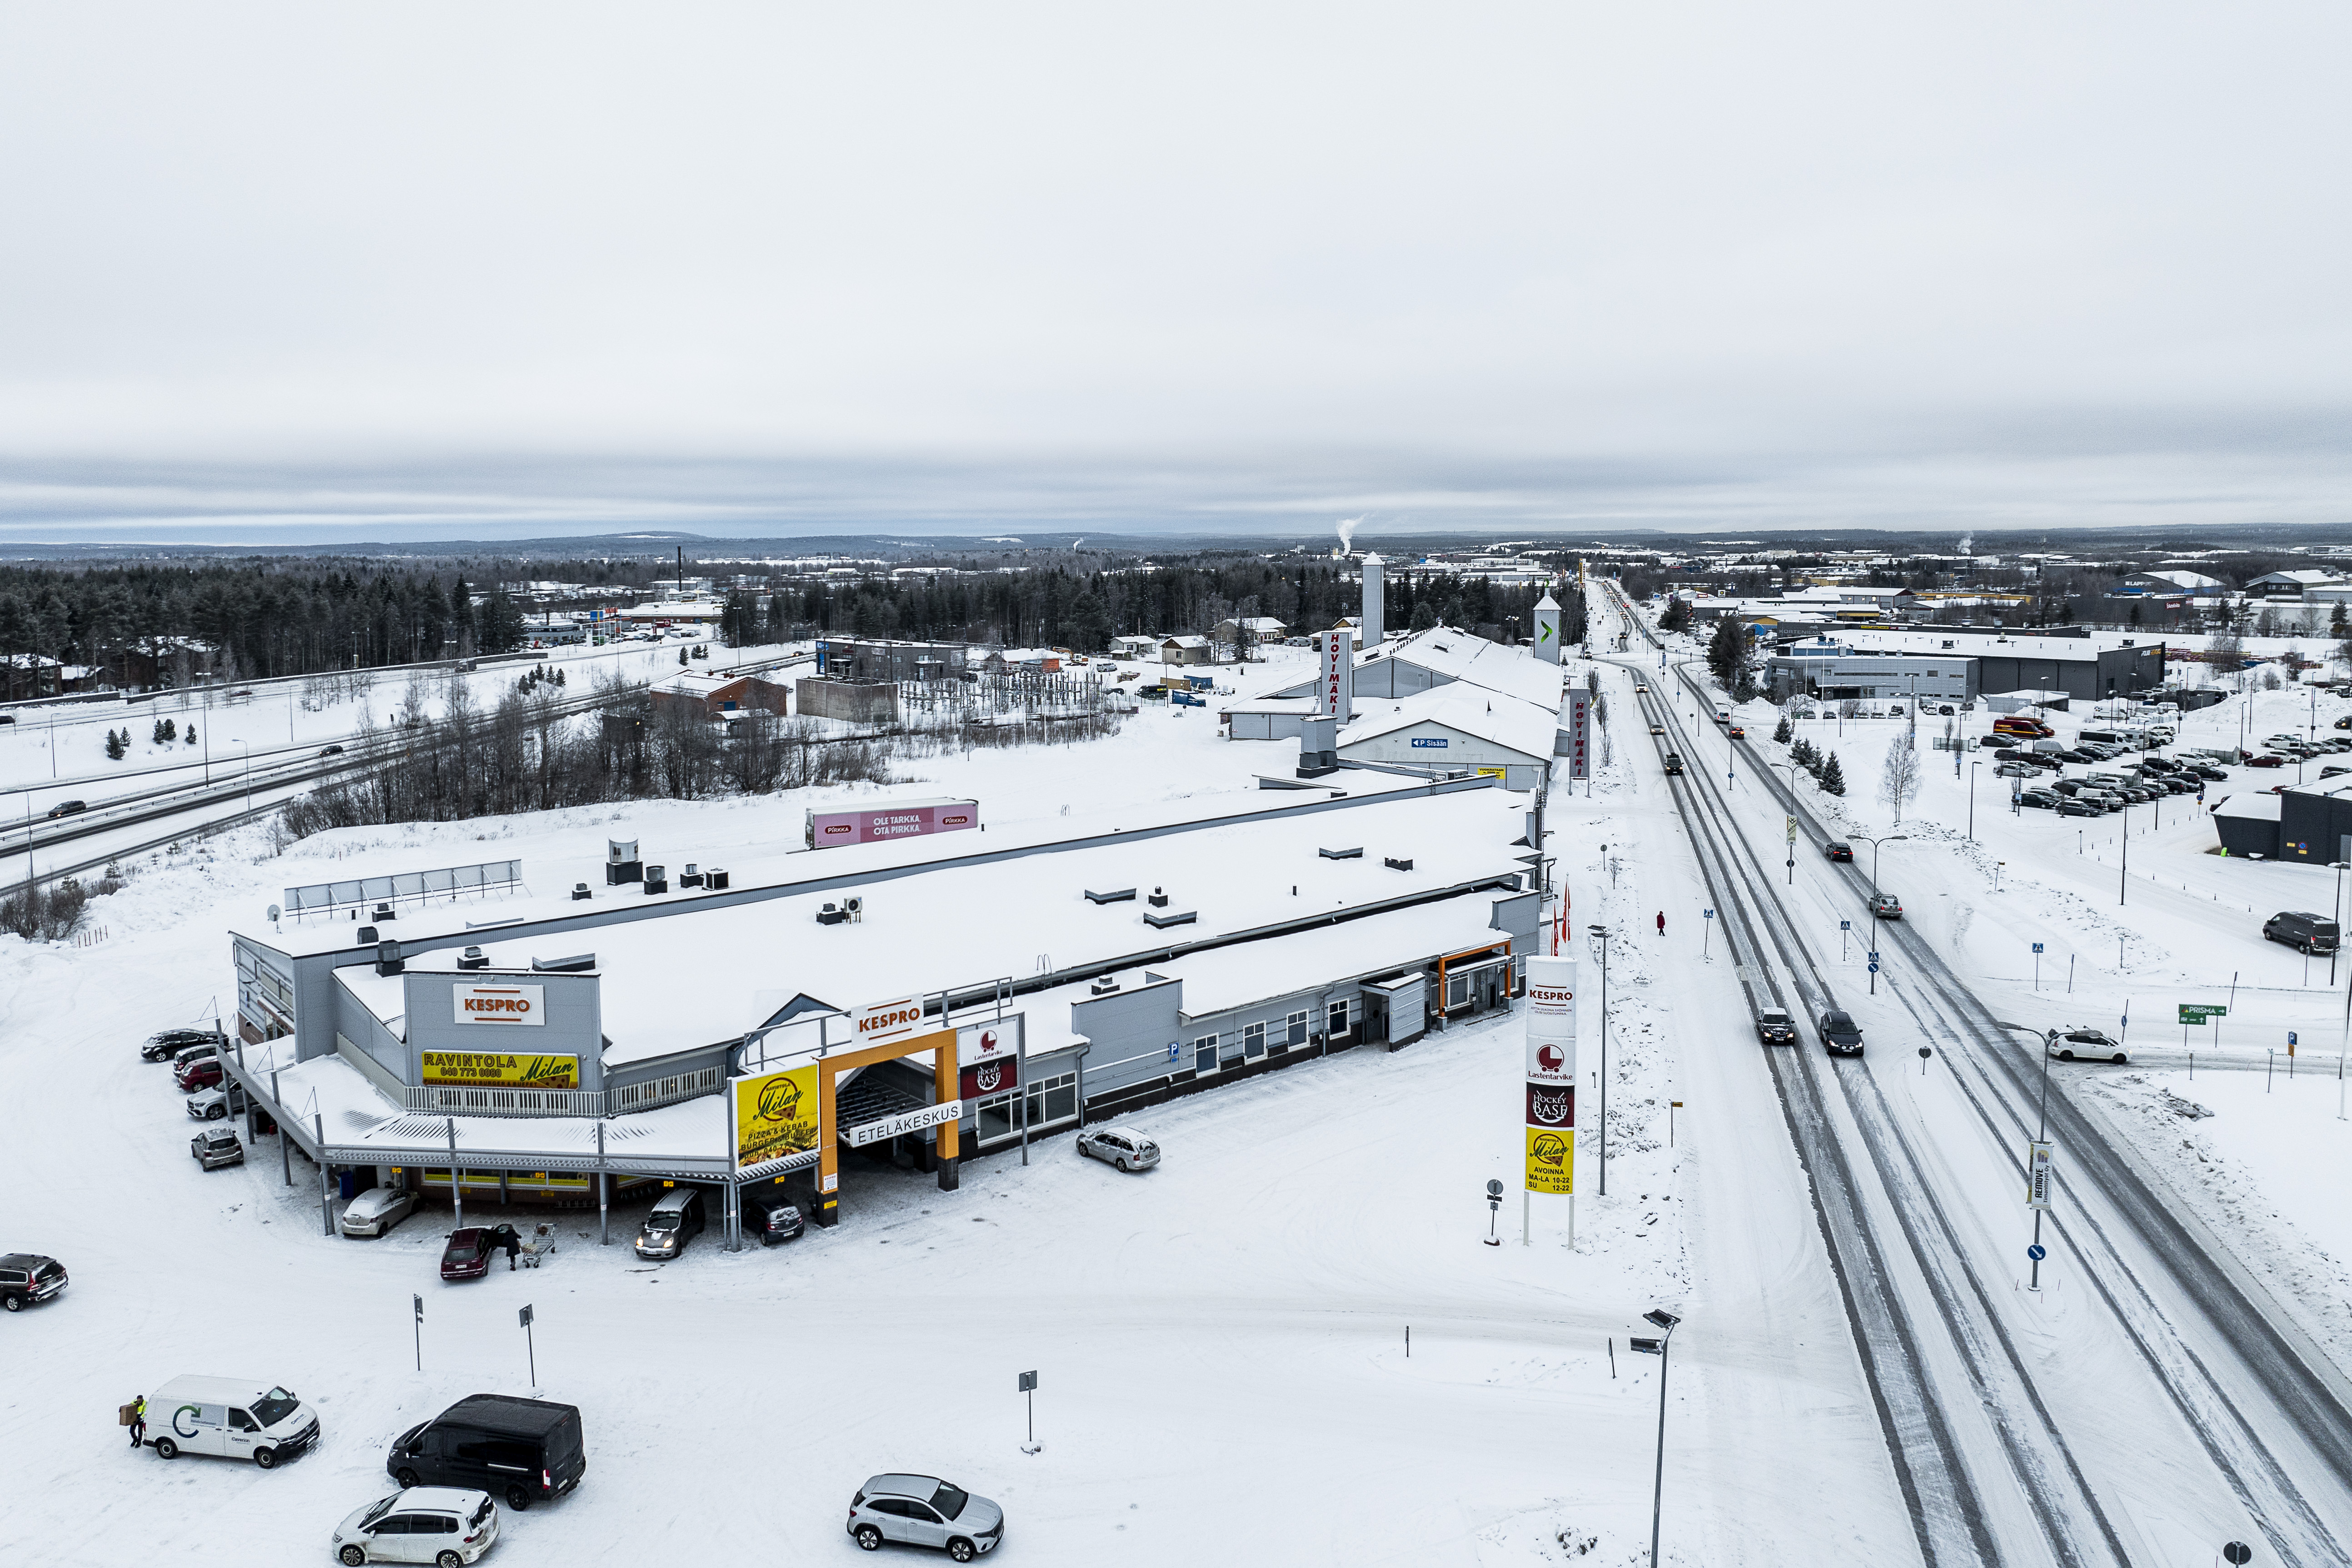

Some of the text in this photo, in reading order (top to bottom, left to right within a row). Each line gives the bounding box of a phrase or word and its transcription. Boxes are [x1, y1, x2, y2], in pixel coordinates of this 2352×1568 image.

[1328, 634, 1340, 713] HOVIMÄKI
[873, 814, 922, 826] OLE TARKKA,
[873, 824, 922, 836] OTA PIRKKA.
[1529, 989, 1573, 1001] KESPRO
[464, 998, 531, 1013] KESPRO
[859, 1007, 920, 1033] KESPRO
[974, 1050, 1003, 1060] Lastentarvike
[424, 1053, 574, 1082] RAVINTOLA Milan
[440, 1066, 502, 1078] 040 773 0080
[978, 1066, 1000, 1075] HOCKEY
[978, 1072, 1001, 1085] BASE
[1528, 1070, 1573, 1080] Lastentarvike
[752, 1088, 804, 1120] Milan
[1534, 1094, 1567, 1104] HOCKEY
[1534, 1101, 1567, 1115] BASE
[748, 1129, 772, 1141] PIZZA
[781, 1120, 808, 1133] KEBAB
[858, 1106, 958, 1143] ETELÄKESKUS
[741, 1137, 776, 1151] BURGER
[764, 1145, 777, 1155] 040
[795, 1137, 812, 1145] 0080
[1530, 1141, 1569, 1157] Milan
[1534, 1166, 1565, 1175] AVOINNA
[1529, 1173, 1550, 1183] MA-LA
[2034, 1168, 2043, 1198] REMOVE
